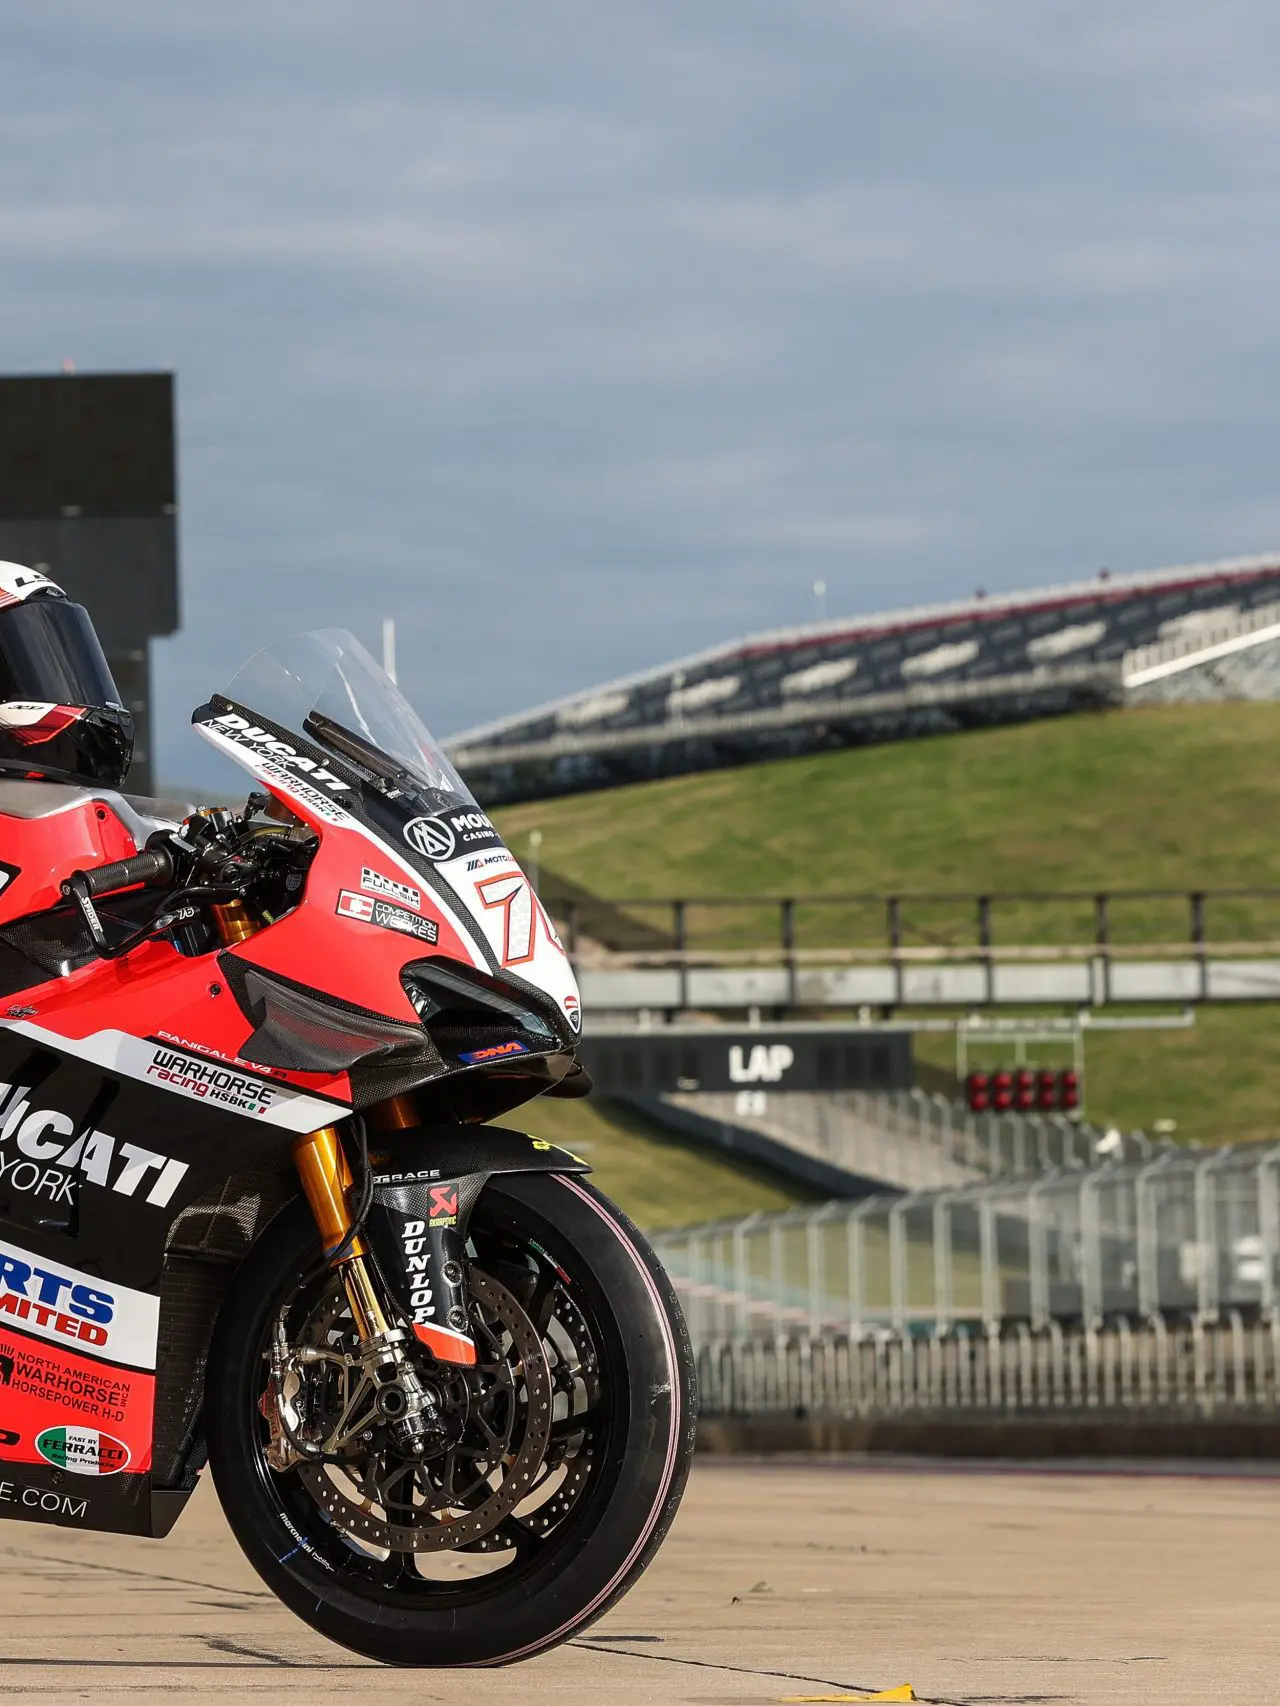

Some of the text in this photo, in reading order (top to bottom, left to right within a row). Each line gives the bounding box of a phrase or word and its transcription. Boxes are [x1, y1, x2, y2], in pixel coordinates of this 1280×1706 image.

[201, 719, 296, 768] NEW YORK
[214, 713, 351, 790] DUCATI
[262, 762, 350, 820] WARHORSE
[451, 813, 494, 832] MOU
[81, 896, 100, 930] SPIDER
[375, 903, 437, 931] COMPETITION
[375, 911, 437, 942] WERKES
[157, 1030, 249, 1066] PANIGALE
[728, 1045, 794, 1082] LAP
[146, 1065, 209, 1097] racing
[209, 1089, 250, 1110] HSBK
[153, 1050, 277, 1105] WARHORSE
[392, 1169, 440, 1180] RACE
[401, 1220, 436, 1324] DUNLOP
[16, 1361, 129, 1408] WARHORSE INC
[17, 1351, 131, 1393] NORTH AMERICAN
[11, 1378, 125, 1422] HORSEPOWER H-D
[42, 1439, 124, 1460] FERRACCI
